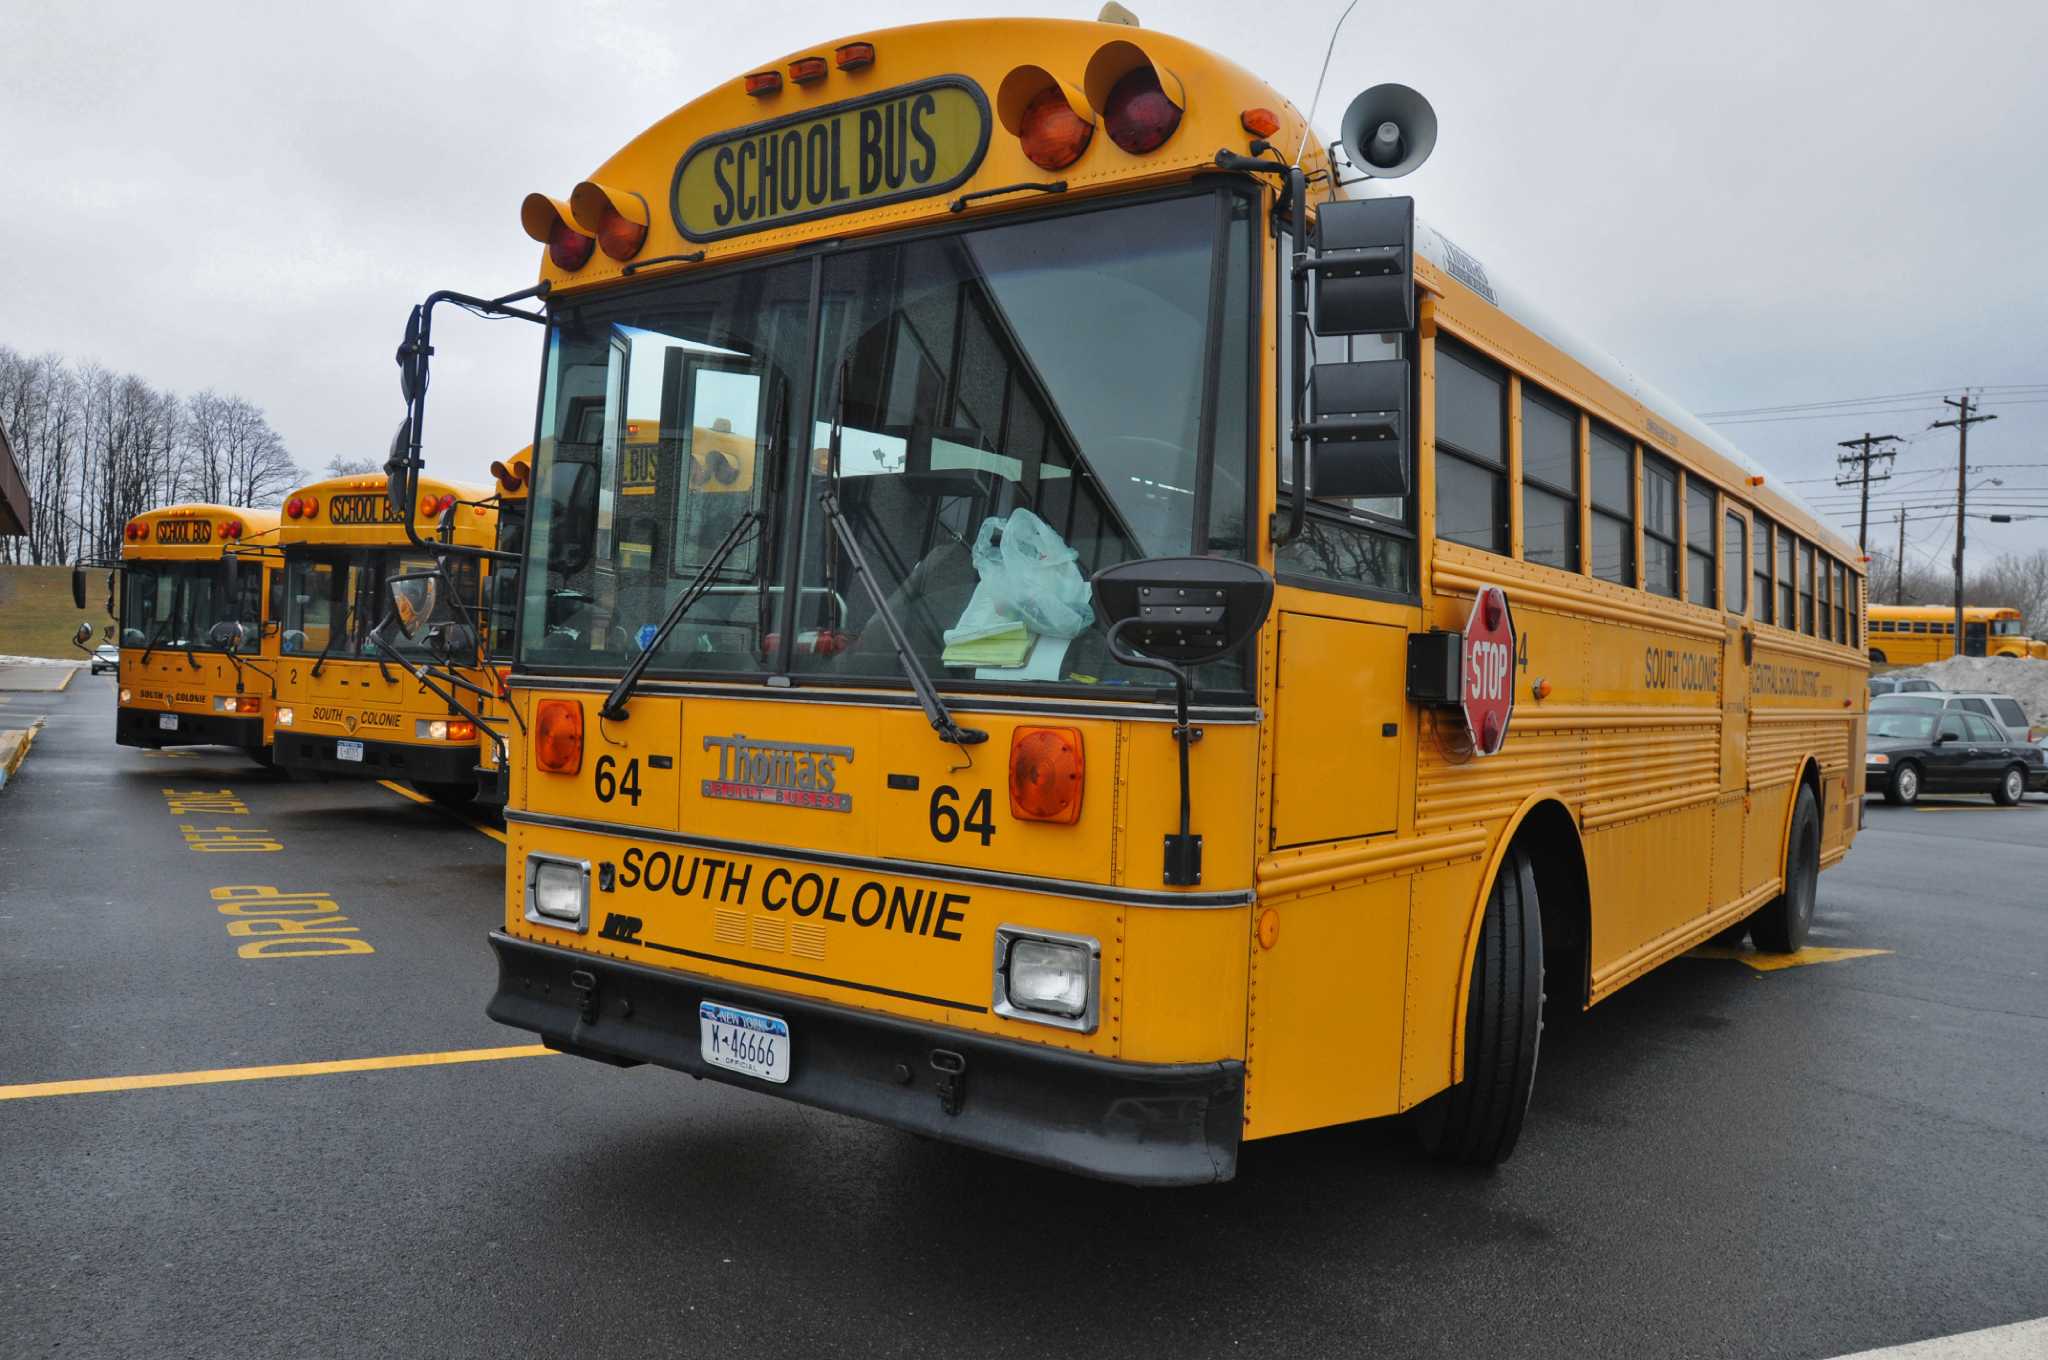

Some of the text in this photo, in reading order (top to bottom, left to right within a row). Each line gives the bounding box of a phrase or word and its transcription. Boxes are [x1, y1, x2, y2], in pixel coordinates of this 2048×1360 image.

[713, 93, 936, 227] SCHOOL BUS
[333, 496, 378, 522] SCHOOL
[158, 521, 189, 543] SCHOOL
[290, 668, 298, 685] 2
[1471, 640, 1508, 700] STOP
[1645, 646, 1680, 689] SOUTH
[1681, 651, 1718, 691] COLONIE
[312, 706, 402, 727] SOUTH COLONIE
[594, 754, 642, 807] 64
[703, 733, 855, 793] Thomas
[775, 788, 835, 809] BUSES
[928, 784, 996, 847] 64
[180, 824, 285, 852] OFF
[618, 846, 972, 942] SOUTH COLONIE
[210, 885, 376, 959] DROP
[731, 1028, 774, 1067] 46666
